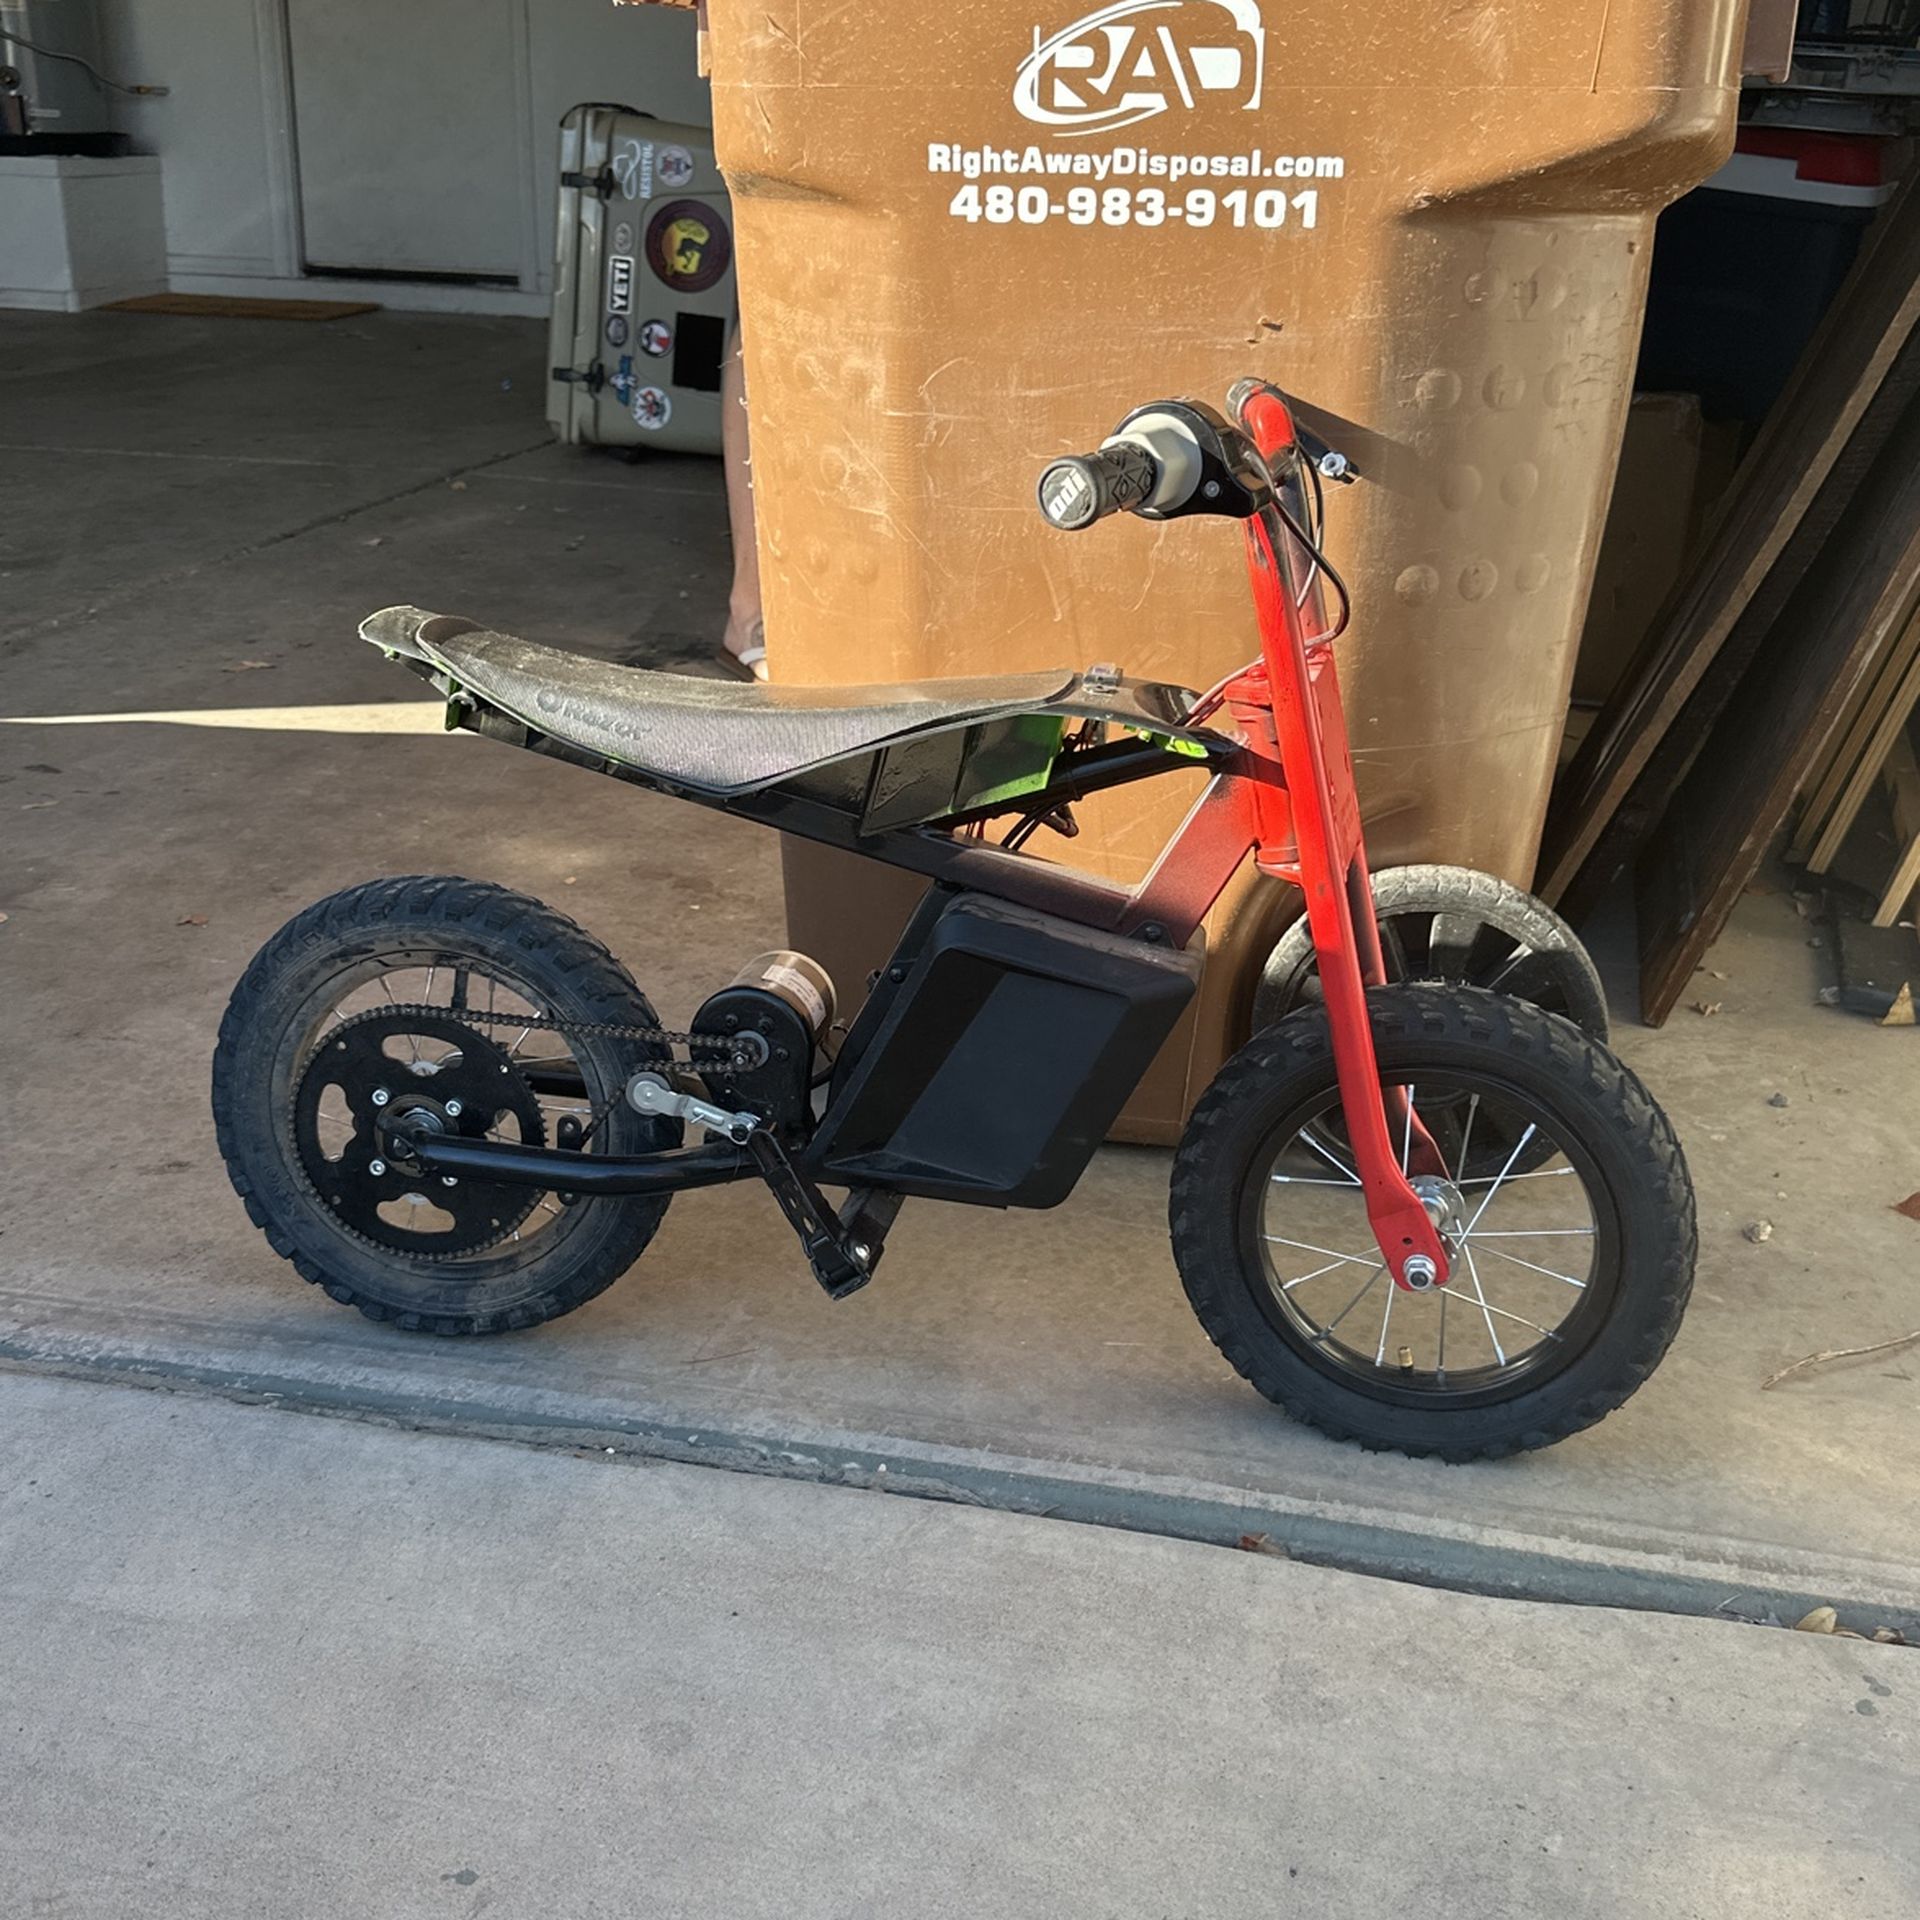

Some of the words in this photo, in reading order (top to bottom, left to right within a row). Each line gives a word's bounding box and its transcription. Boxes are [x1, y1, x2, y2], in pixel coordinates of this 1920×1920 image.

[927, 143, 1345, 181] RightAwayDisposal.com
[948, 185, 1319, 229] 480-983-9101
[611, 258, 630, 309] YETI
